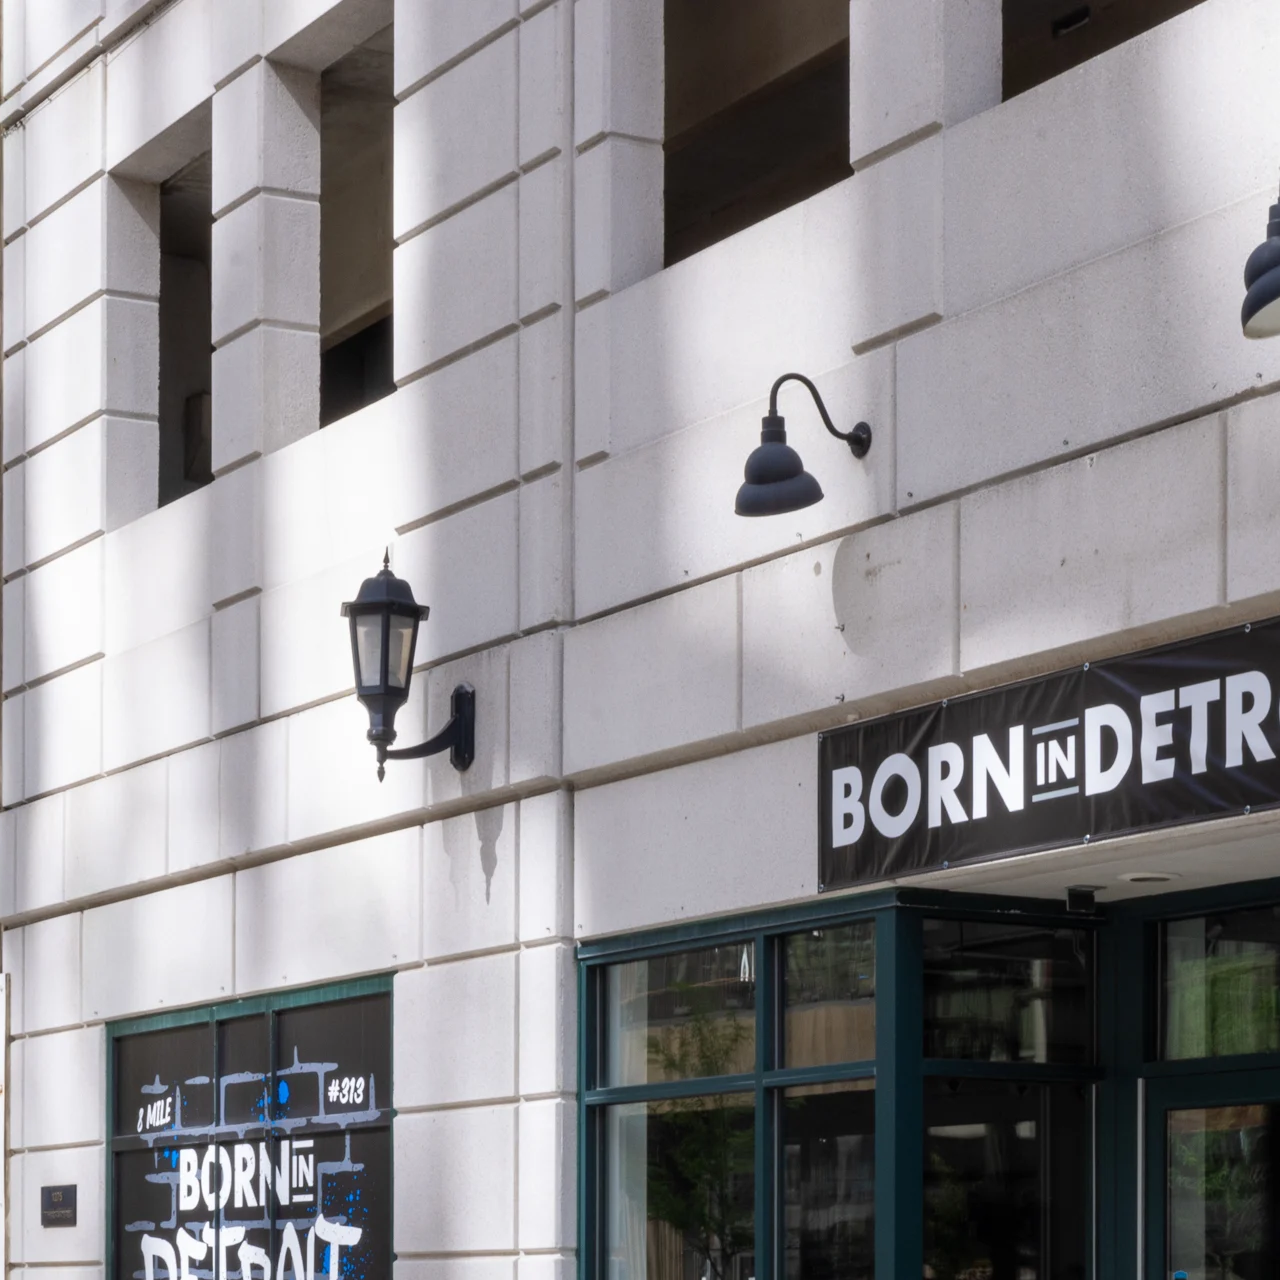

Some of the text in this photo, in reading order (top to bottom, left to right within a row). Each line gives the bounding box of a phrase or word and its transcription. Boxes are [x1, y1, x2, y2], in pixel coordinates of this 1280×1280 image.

[831, 724, 1024, 849] BORN
[1036, 735, 1076, 787] IN
[136, 1096, 173, 1133] 8 MILE
[327, 1076, 366, 1105] #313
[179, 1139, 314, 1212] BORN IN
